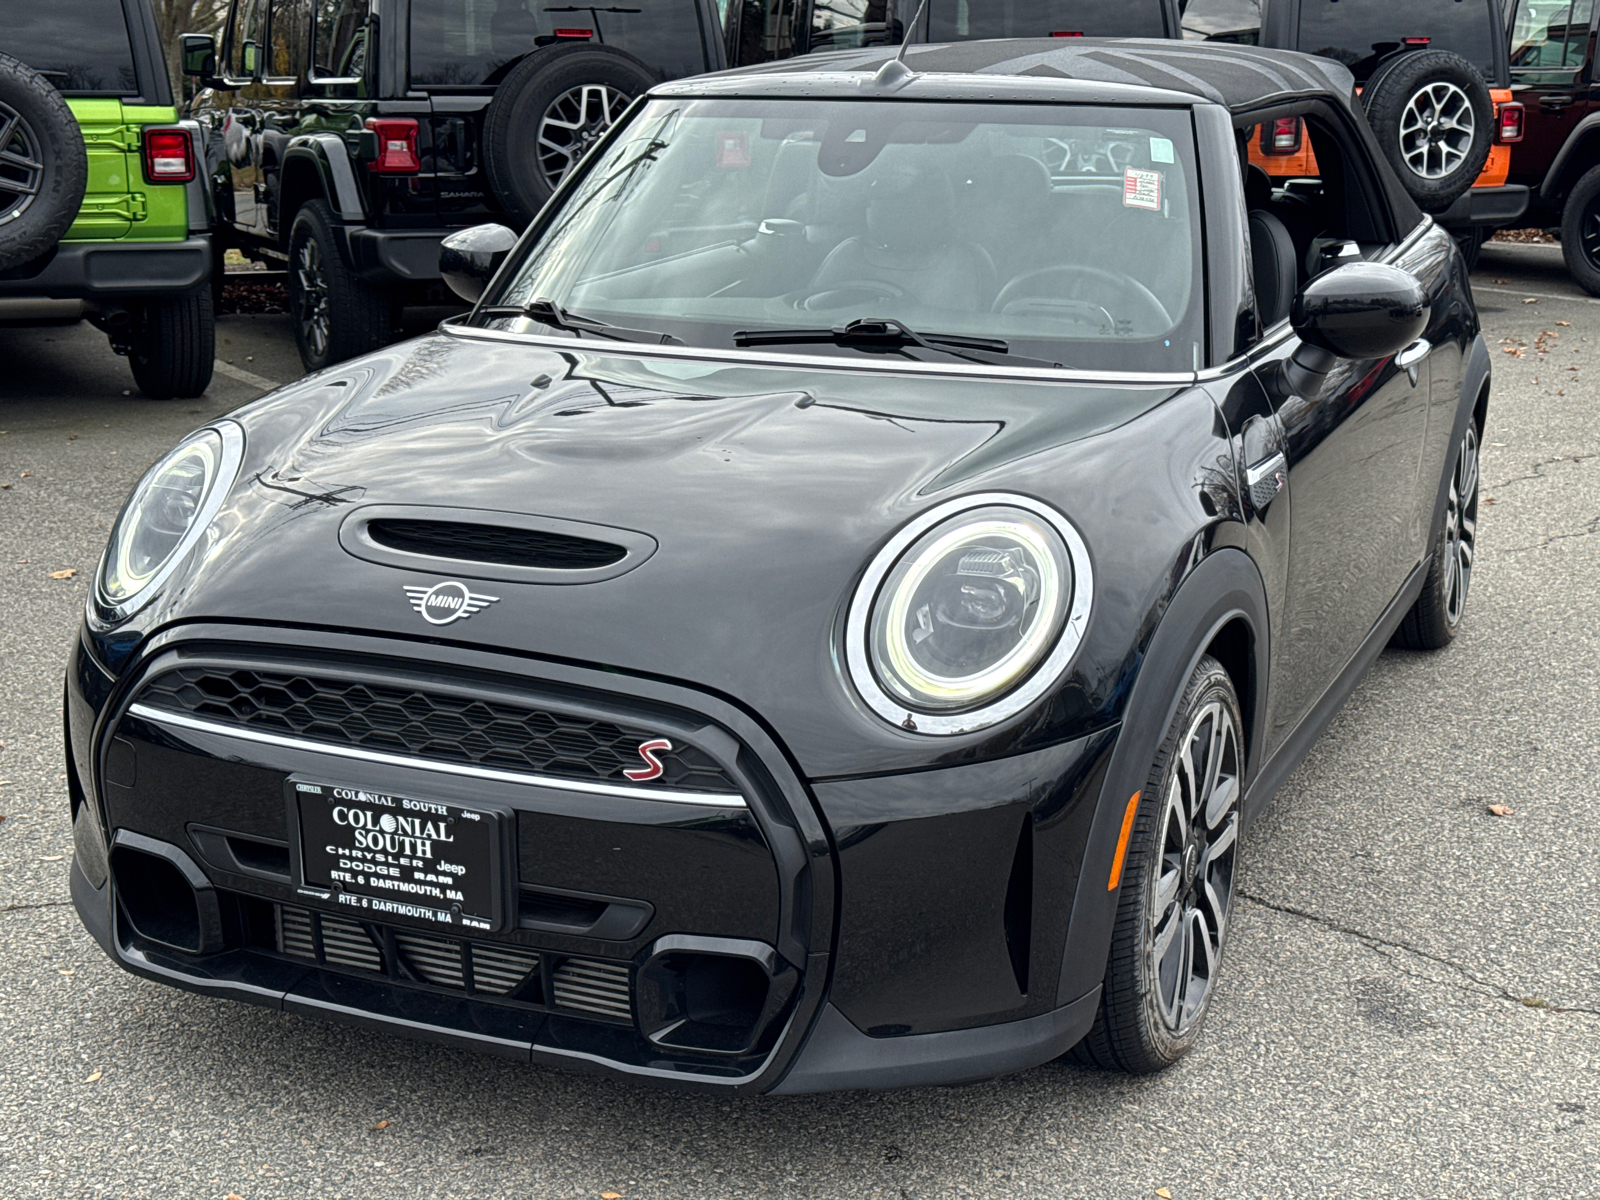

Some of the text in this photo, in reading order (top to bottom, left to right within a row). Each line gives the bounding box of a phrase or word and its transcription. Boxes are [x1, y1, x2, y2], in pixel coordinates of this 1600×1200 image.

[440, 191, 485, 199] SAHARA
[427, 594, 463, 610] MINI
[622, 738, 673, 782] S
[295, 783, 323, 795] CHRYSLER
[333, 788, 448, 816] COLONIAL SOUTH
[332, 806, 454, 843] COLONIAL
[461, 810, 481, 822] Jeep
[354, 829, 434, 859] SOUTH
[325, 845, 466, 876] CHRYSLER Jeep
[338, 859, 453, 885] DODGE RAM
[330, 870, 464, 902] RTE. 6 DARTMOUTH, MA
[338, 893, 453, 924] RTE. 6 DARTMOUTH, MA
[462, 918, 491, 930] RAM
